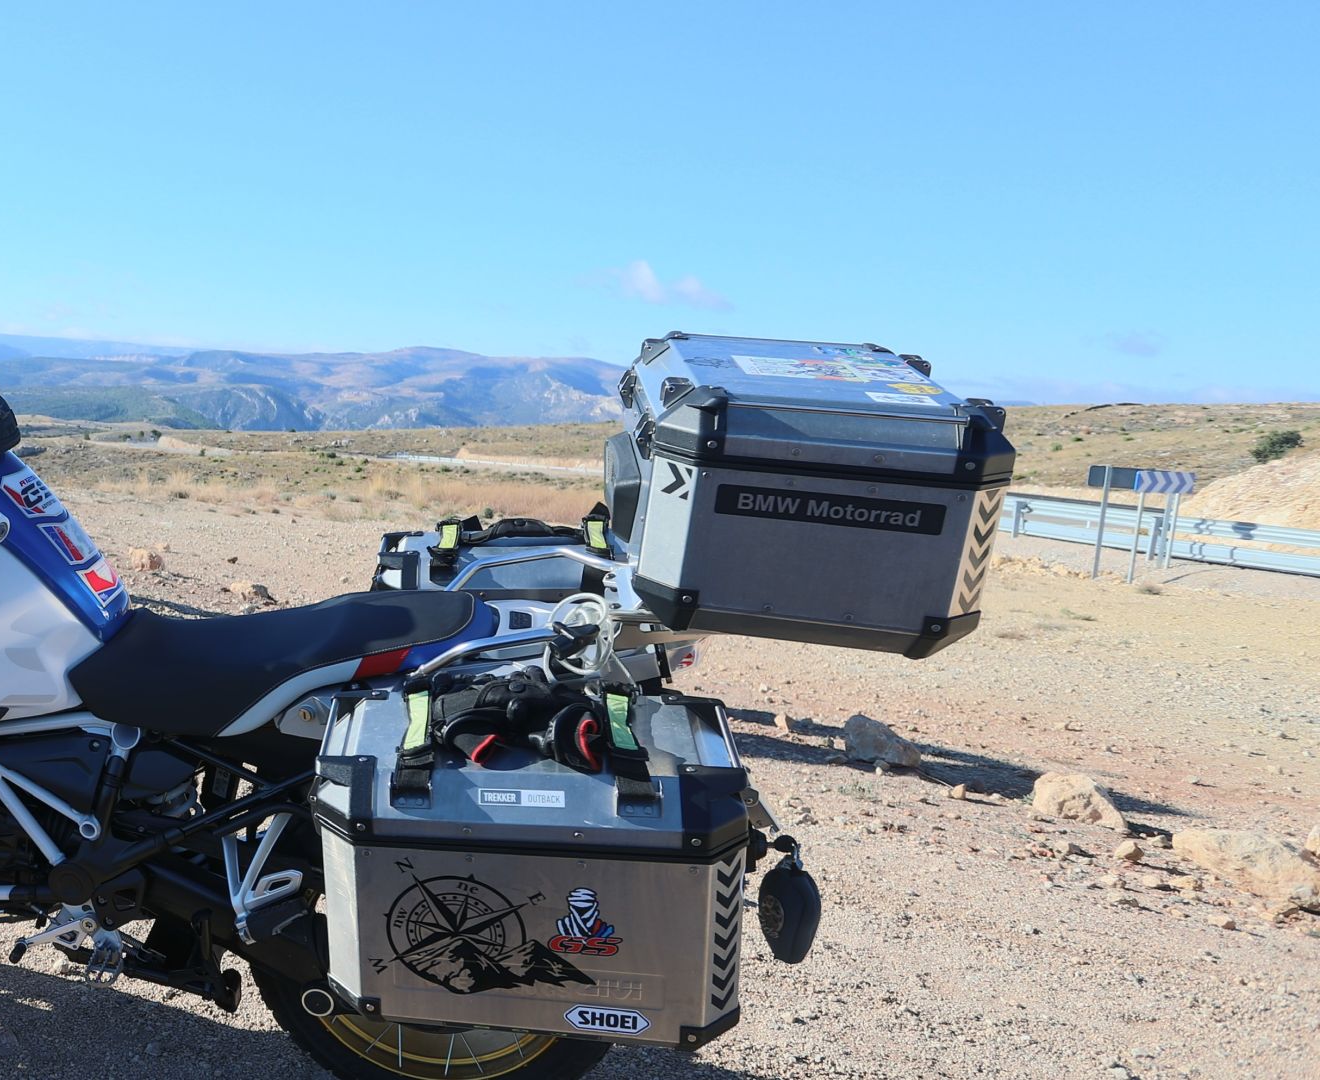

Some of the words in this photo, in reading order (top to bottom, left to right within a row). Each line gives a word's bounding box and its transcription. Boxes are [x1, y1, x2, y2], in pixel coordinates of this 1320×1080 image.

[737, 492, 800, 514] BMW
[806, 499, 922, 527] Motorrad
[483, 792, 517, 803] TREKKER
[527, 794, 560, 804] OUTBACK
[394, 857, 414, 873] N
[456, 881, 480, 895] ne
[527, 891, 547, 906] E
[548, 934, 623, 956] GS
[578, 1010, 638, 1030] SHOEI
